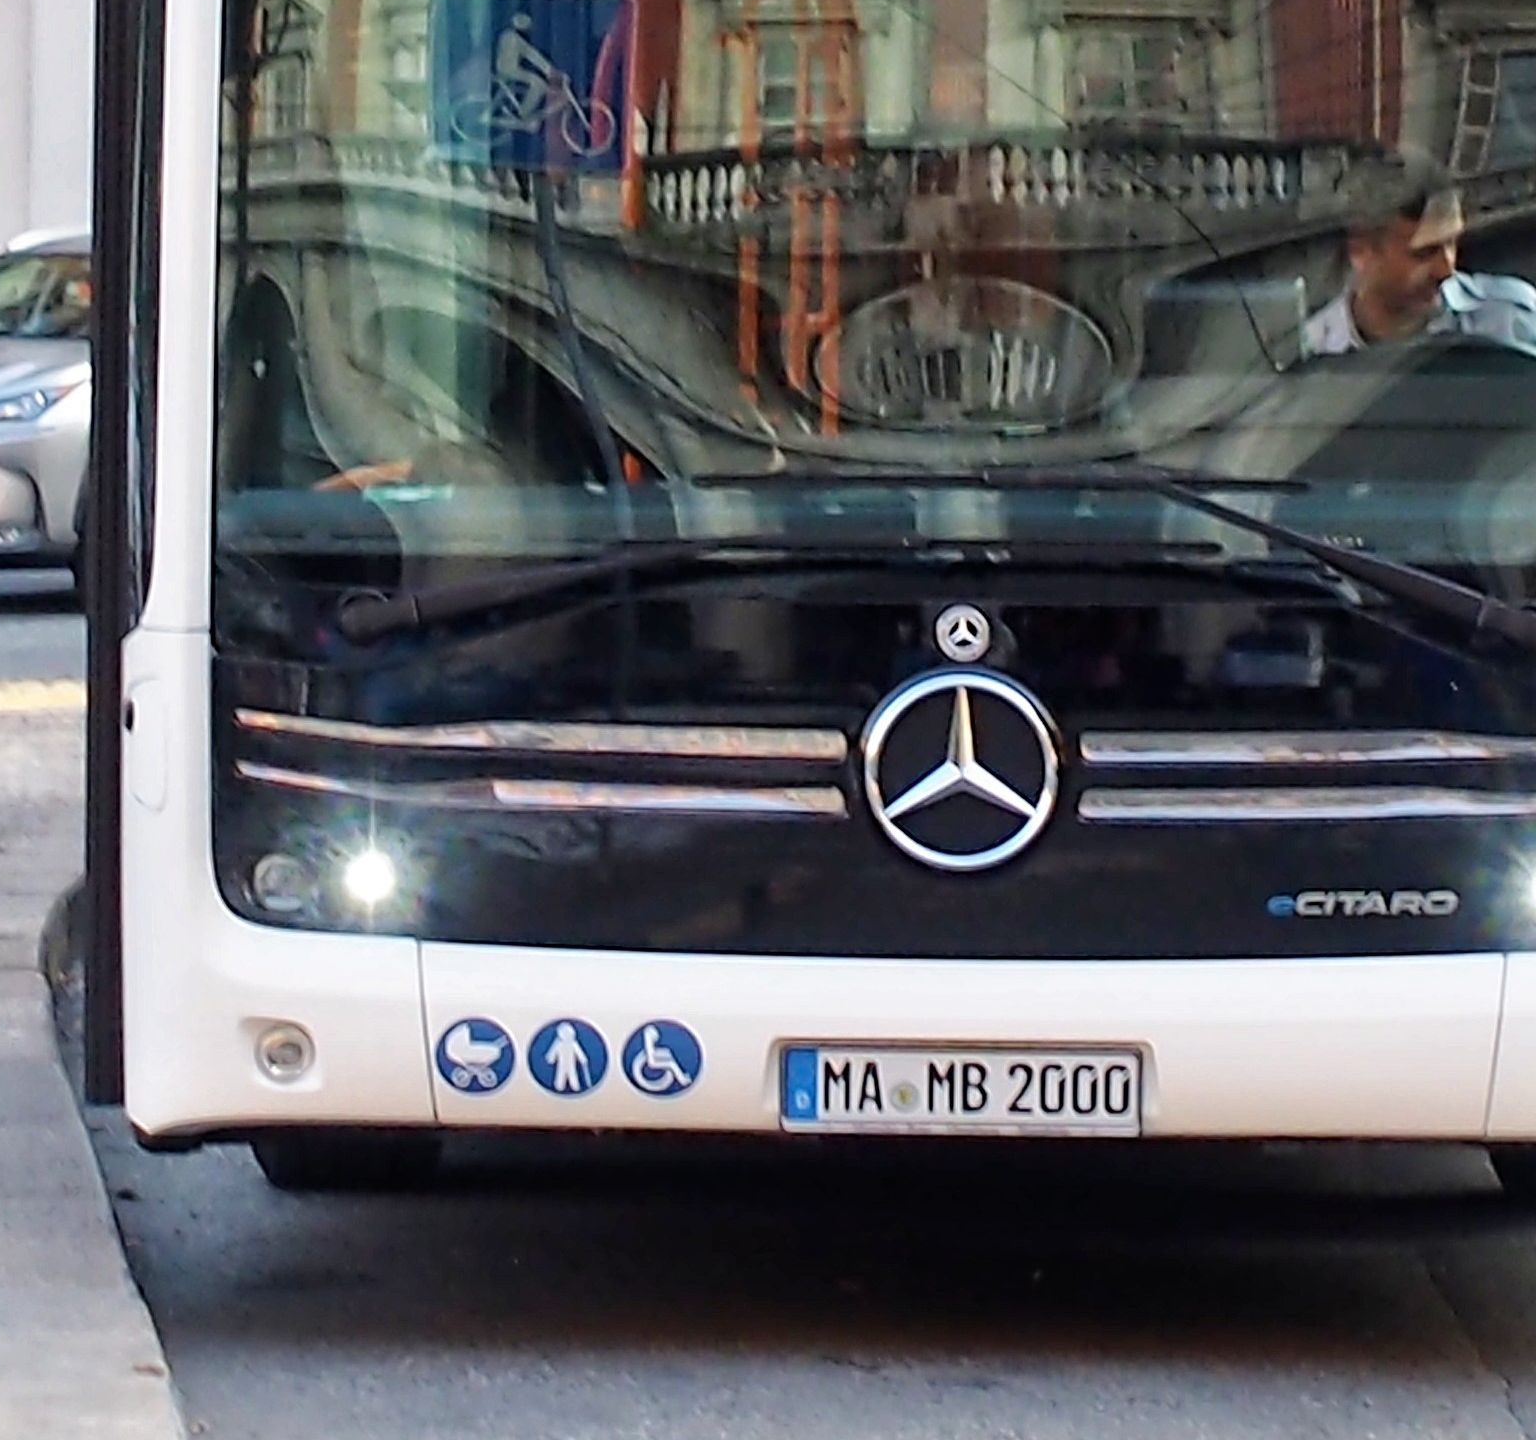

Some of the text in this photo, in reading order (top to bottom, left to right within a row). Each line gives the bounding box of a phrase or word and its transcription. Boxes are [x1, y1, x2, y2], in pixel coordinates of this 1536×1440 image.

[824, 1061, 1131, 1114] MA MB 2000
